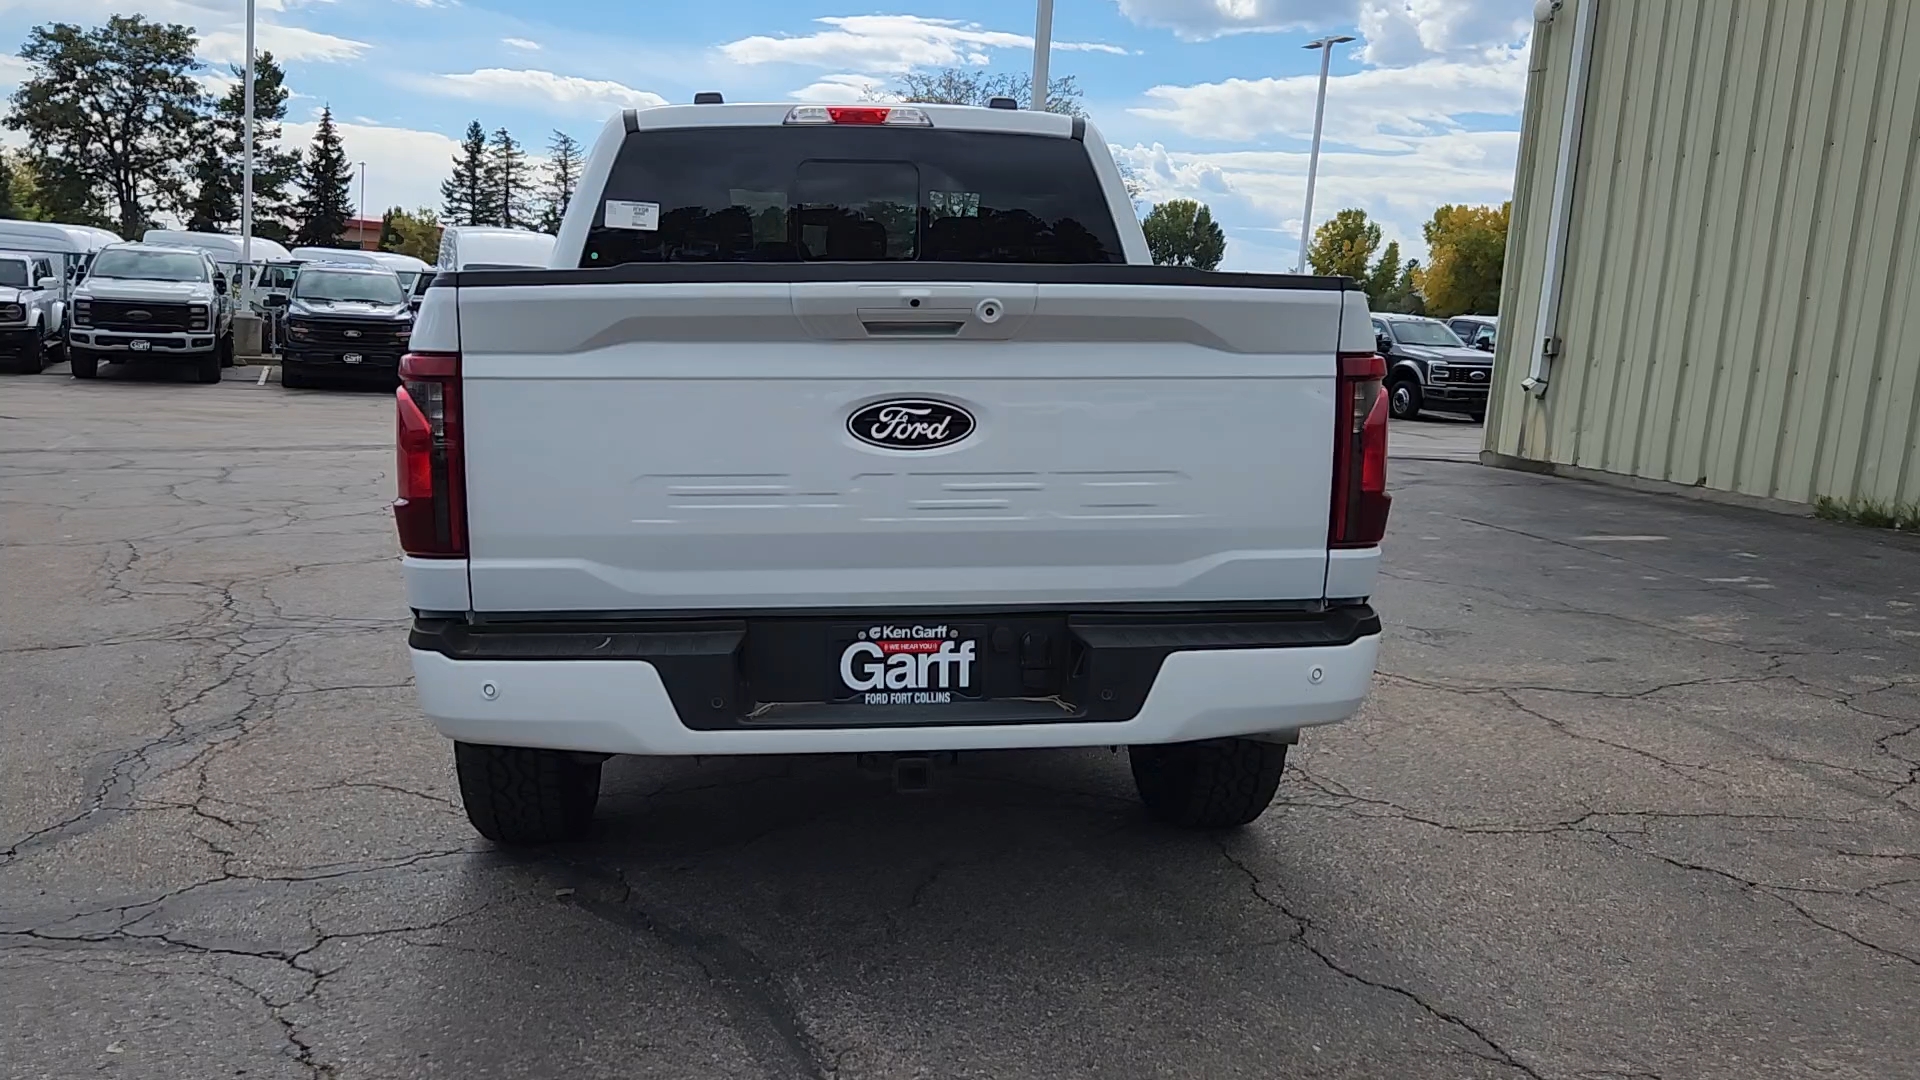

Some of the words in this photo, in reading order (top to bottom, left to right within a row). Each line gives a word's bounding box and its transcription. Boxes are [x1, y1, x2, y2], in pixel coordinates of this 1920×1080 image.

[871, 406, 952, 440] Ford
[883, 625, 910, 639] Ken
[912, 625, 947, 639] Garff
[919, 642, 932, 650] YOU
[840, 640, 975, 691] Garff
[865, 693, 888, 704] FORD
[890, 692, 913, 704] FORT
[914, 691, 951, 704] COLLINS
